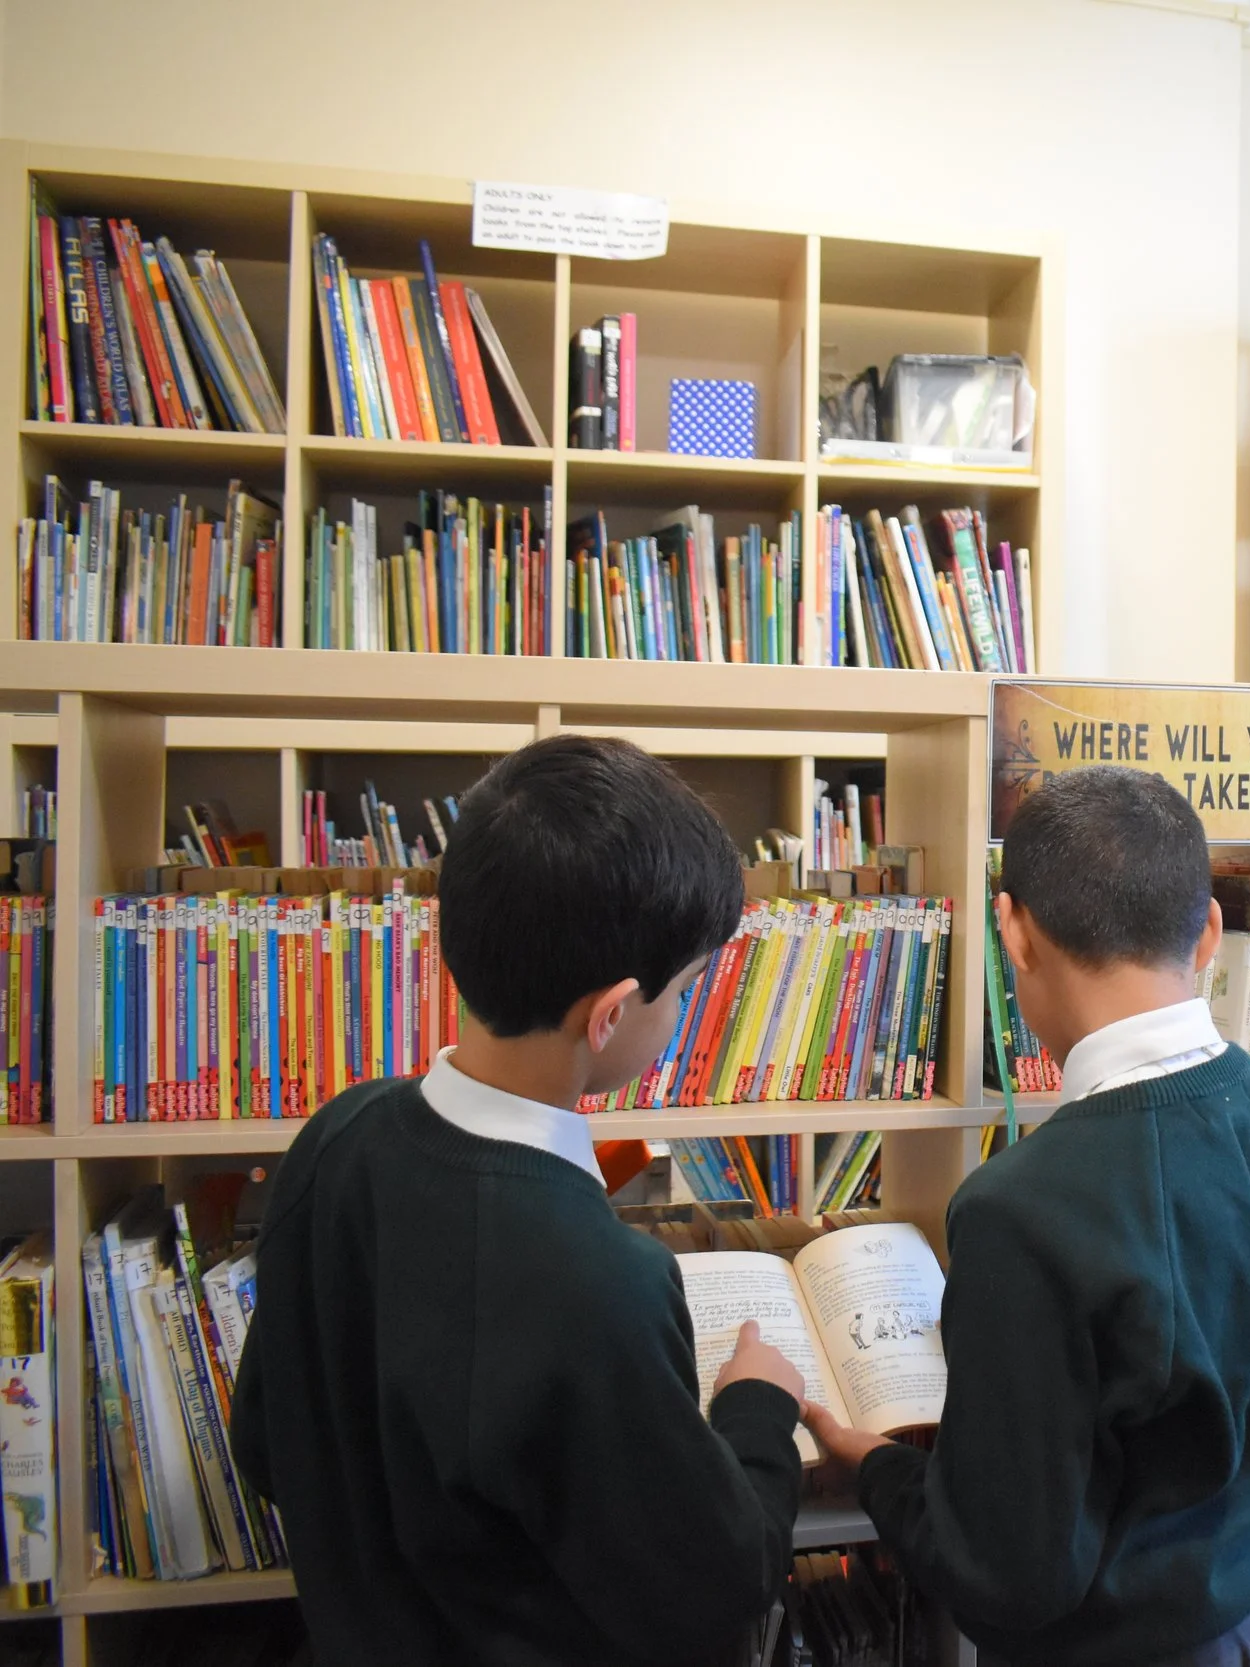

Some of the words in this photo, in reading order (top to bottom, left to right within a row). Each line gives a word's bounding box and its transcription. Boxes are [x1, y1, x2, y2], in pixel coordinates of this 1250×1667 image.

[484, 188, 523, 199] ADULTS
[526, 192, 552, 201] ONLY
[482, 204, 520, 214] Children
[528, 208, 543, 216] are
[574, 211, 607, 222] allowed
[482, 217, 508, 227] books
[514, 220, 536, 228] from
[540, 222, 554, 230] the
[558, 224, 572, 234] top
[617, 229, 644, 238] Please
[497, 232, 520, 241] adult
[524, 234, 533, 242] to
[561, 236, 574, 246] the
[579, 238, 599, 248] book
[65, 237, 90, 324] ATLAS
[95, 260, 116, 329] CHILDREN'S
[107, 331, 124, 373] WORLD
[114, 374, 130, 412] ATLAS
[962, 567, 981, 608] LIFE
[972, 607, 994, 656] WILD
[1054, 722, 1149, 760] WHERE
[1166, 725, 1231, 762] WILL
[1183, 773, 1250, 810] TAKE
[392, 893, 402, 906] 9
[247, 916, 258, 928] 9
[886, 910, 896, 922] 9
[742, 937, 756, 972] Animals
[852, 956, 860, 968] The
[208, 963, 216, 989] Whoops,
[739, 972, 748, 983] on
[783, 974, 791, 986] FOR
[849, 967, 858, 980] Ugly
[857, 979, 864, 988] My
[251, 980, 257, 989] My
[735, 983, 746, 998] the
[804, 981, 812, 996] CARS
[837, 982, 845, 1001] school
[177, 992, 185, 1009] Piper
[844, 982, 855, 1010] Duckling
[210, 1008, 216, 1016] go
[729, 998, 740, 1019] Move
[774, 998, 785, 1018] MOON
[830, 1001, 842, 1034] photograph
[210, 1017, 216, 1027] my
[860, 1007, 869, 1033] Snowman
[889, 1018, 898, 1048] Musketeers
[783, 1065, 791, 1080] Little
[818, 1069, 828, 1094] Ladybird
[827, 1067, 838, 1093] Ladybird
[780, 1080, 788, 1093] Owl
[178, 1086, 186, 1113] Ladybird
[188, 1085, 196, 1112] Ladybird
[210, 1084, 218, 1111] Ladybird
[261, 1084, 269, 1111] Ladybird
[290, 1084, 298, 1111] Ladybird
[174, 1324, 188, 1352] POOLEY
[10, 1356, 31, 1370] 17
[184, 1368, 192, 1378] A
[186, 1378, 200, 1400] Day
[193, 1401, 202, 1414] of
[196, 1416, 213, 1462] Rhymes
[202, 1384, 212, 1408] POEMS
[210, 1420, 231, 1474] CONSERVATION
